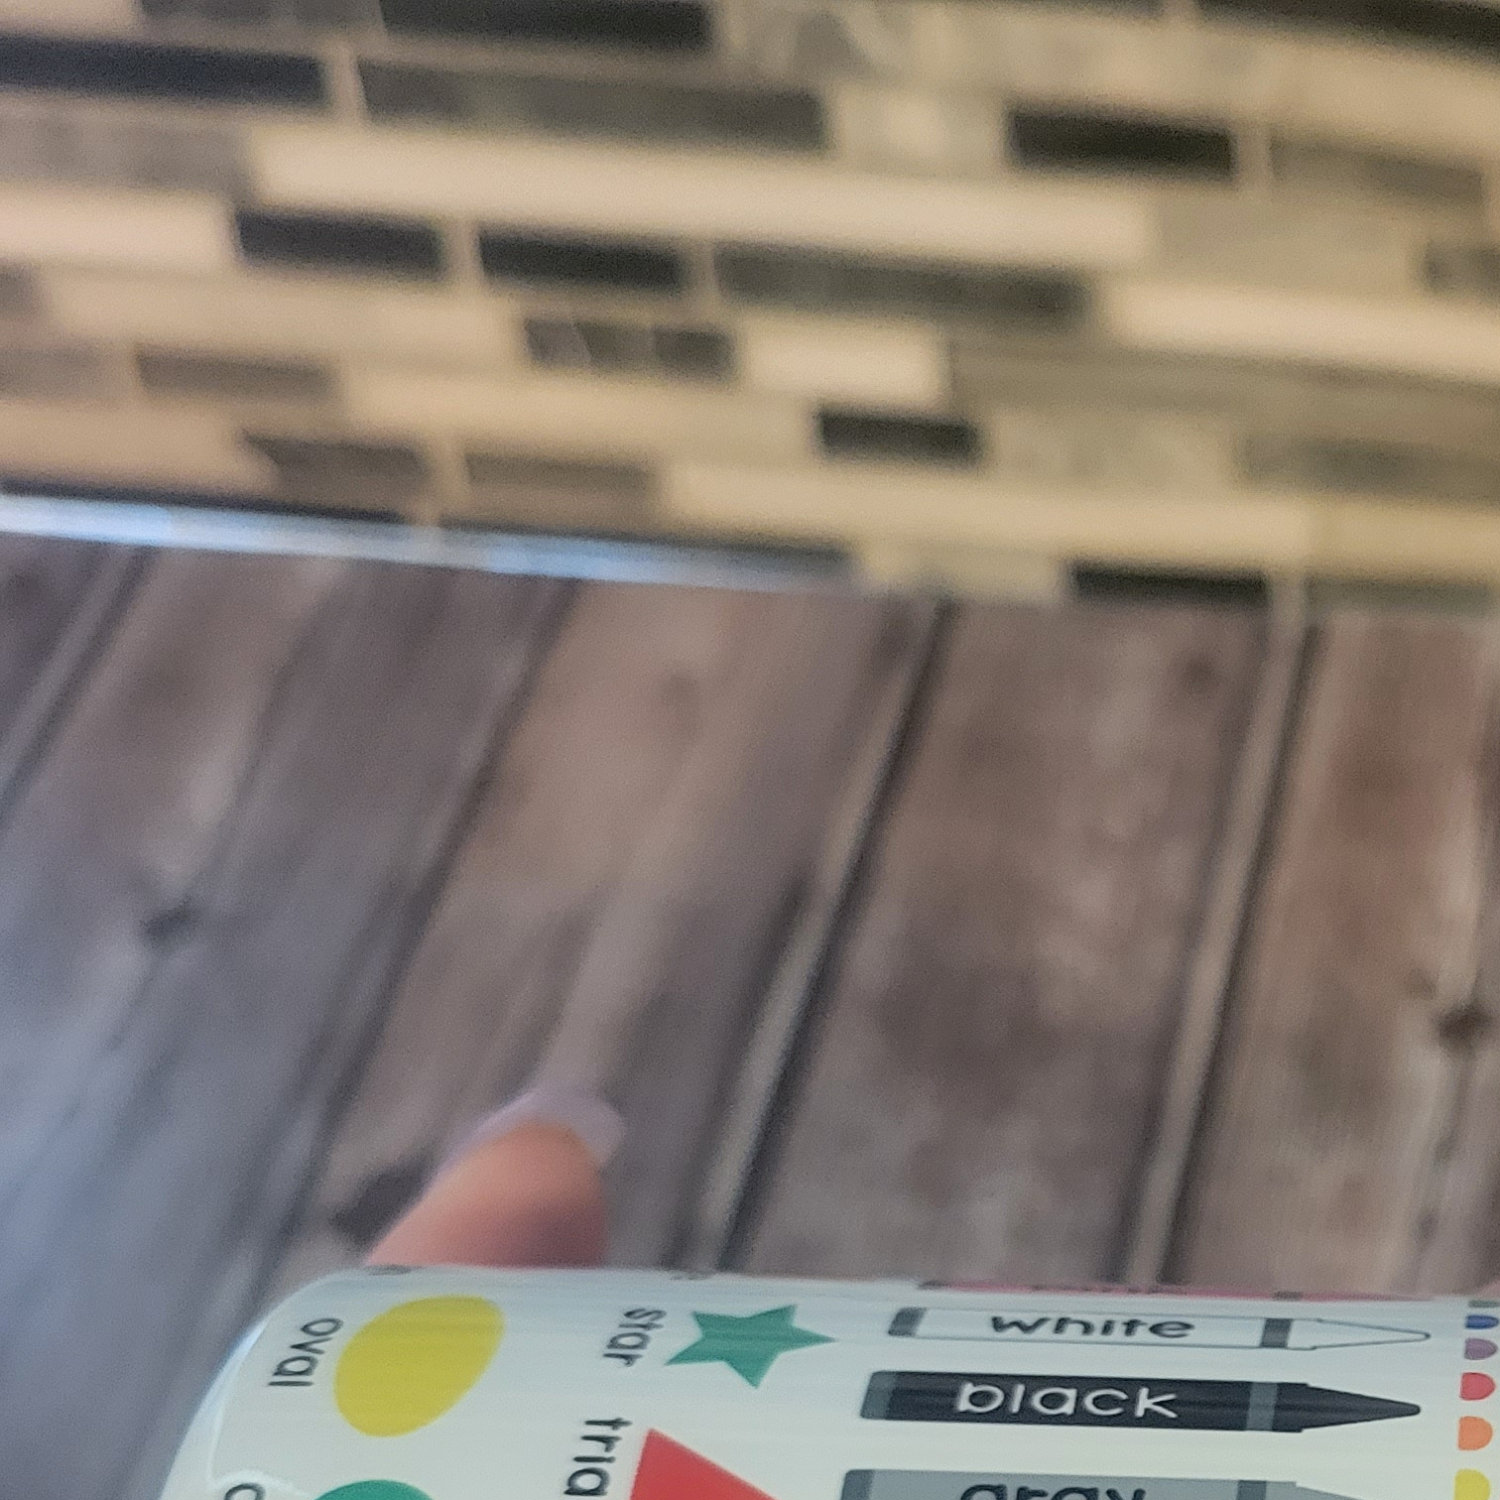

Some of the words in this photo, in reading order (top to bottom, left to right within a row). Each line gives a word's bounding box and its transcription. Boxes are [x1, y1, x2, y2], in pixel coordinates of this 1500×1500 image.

[602, 1307, 667, 1368] star
[990, 1314, 1195, 1339] white
[267, 1316, 343, 1388] oval
[955, 1381, 1178, 1419] black
